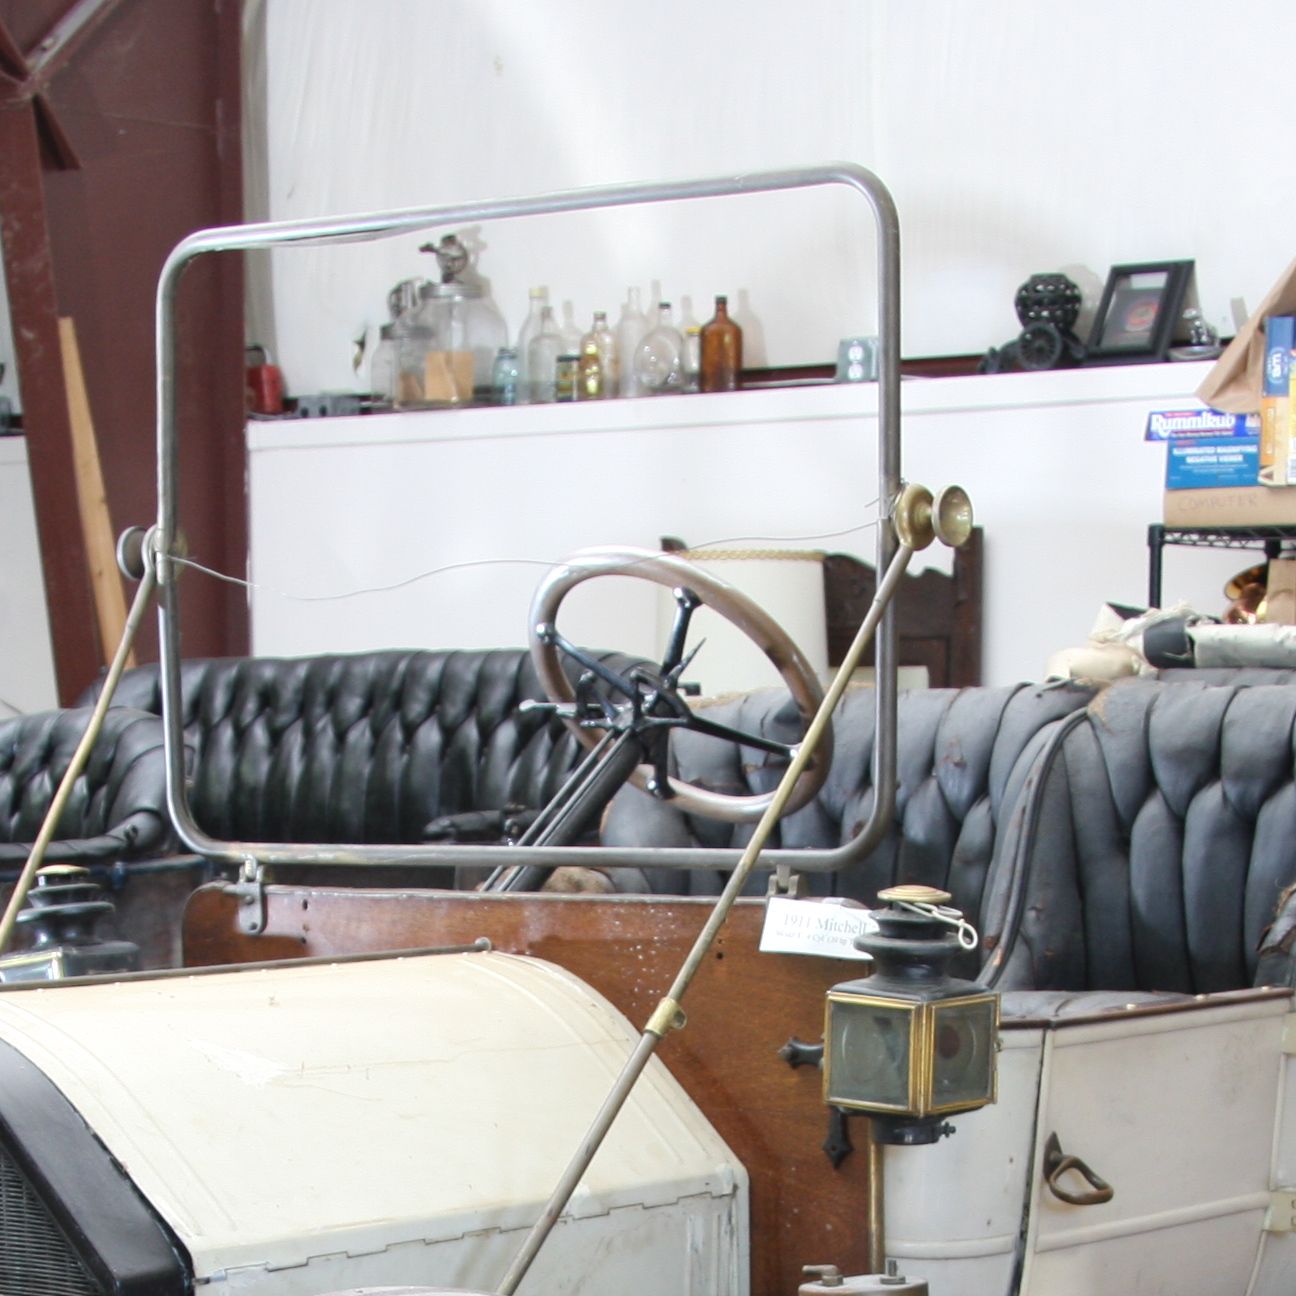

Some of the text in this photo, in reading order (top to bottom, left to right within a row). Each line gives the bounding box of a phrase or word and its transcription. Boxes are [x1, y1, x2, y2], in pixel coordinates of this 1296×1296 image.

[1151, 411, 1235, 438] Rummikub
[783, 913, 868, 935] 1911 Mitchell
